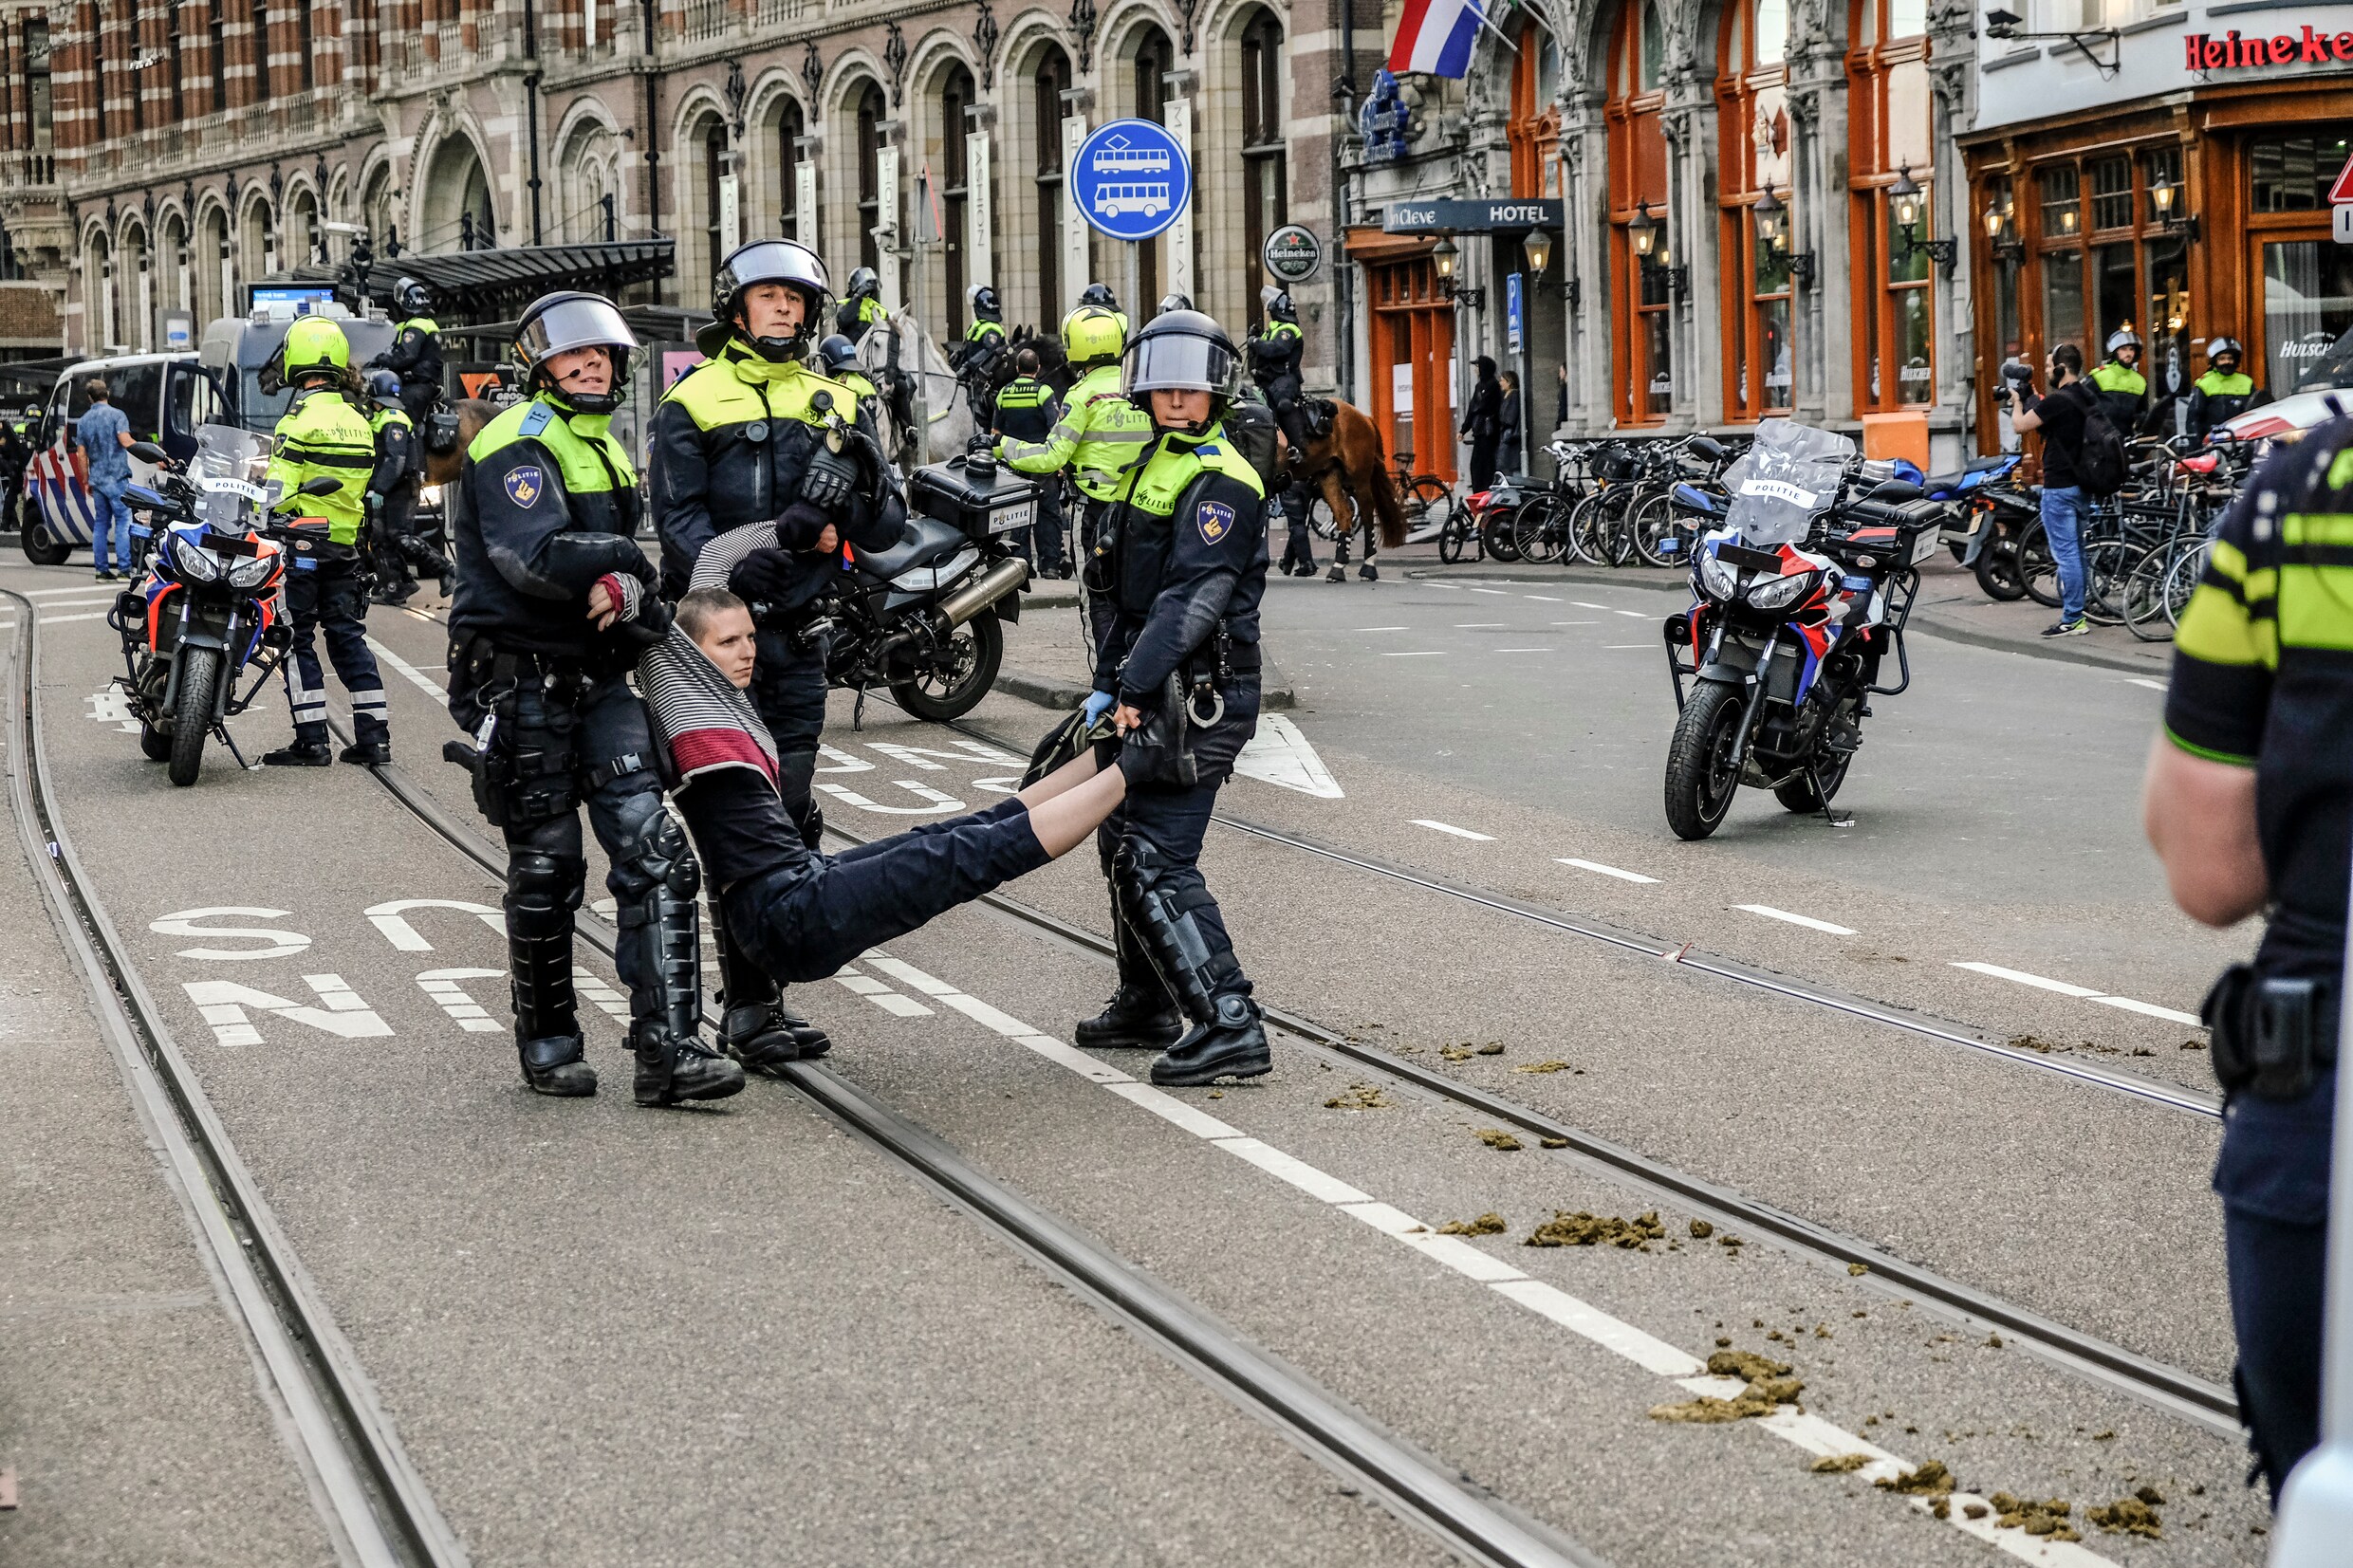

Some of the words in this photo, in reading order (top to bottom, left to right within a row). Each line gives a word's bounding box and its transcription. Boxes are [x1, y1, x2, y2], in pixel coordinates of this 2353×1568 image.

[2184, 25, 2353, 71] Heineke
[1070, 123, 1083, 261] LIYLE
[883, 153, 895, 276] SHOPG
[1490, 205, 1548, 222] HOTEL
[1175, 224, 1185, 294] PLAZ
[1269, 247, 1317, 259] Heineken
[1509, 279, 1516, 309] P
[1085, 334, 1118, 344] POLITIE
[2279, 340, 2334, 359] HULSCH
[528, 410, 547, 423] TE
[1106, 407, 1148, 428] POLITI
[507, 470, 540, 483] POLITIE
[214, 482, 256, 496] POLITIE
[1754, 484, 1801, 501] POLITIE
[1136, 489, 1175, 510] POLITIE
[993, 509, 1028, 526] POLITIE
[1200, 504, 1232, 519] POLITIE
